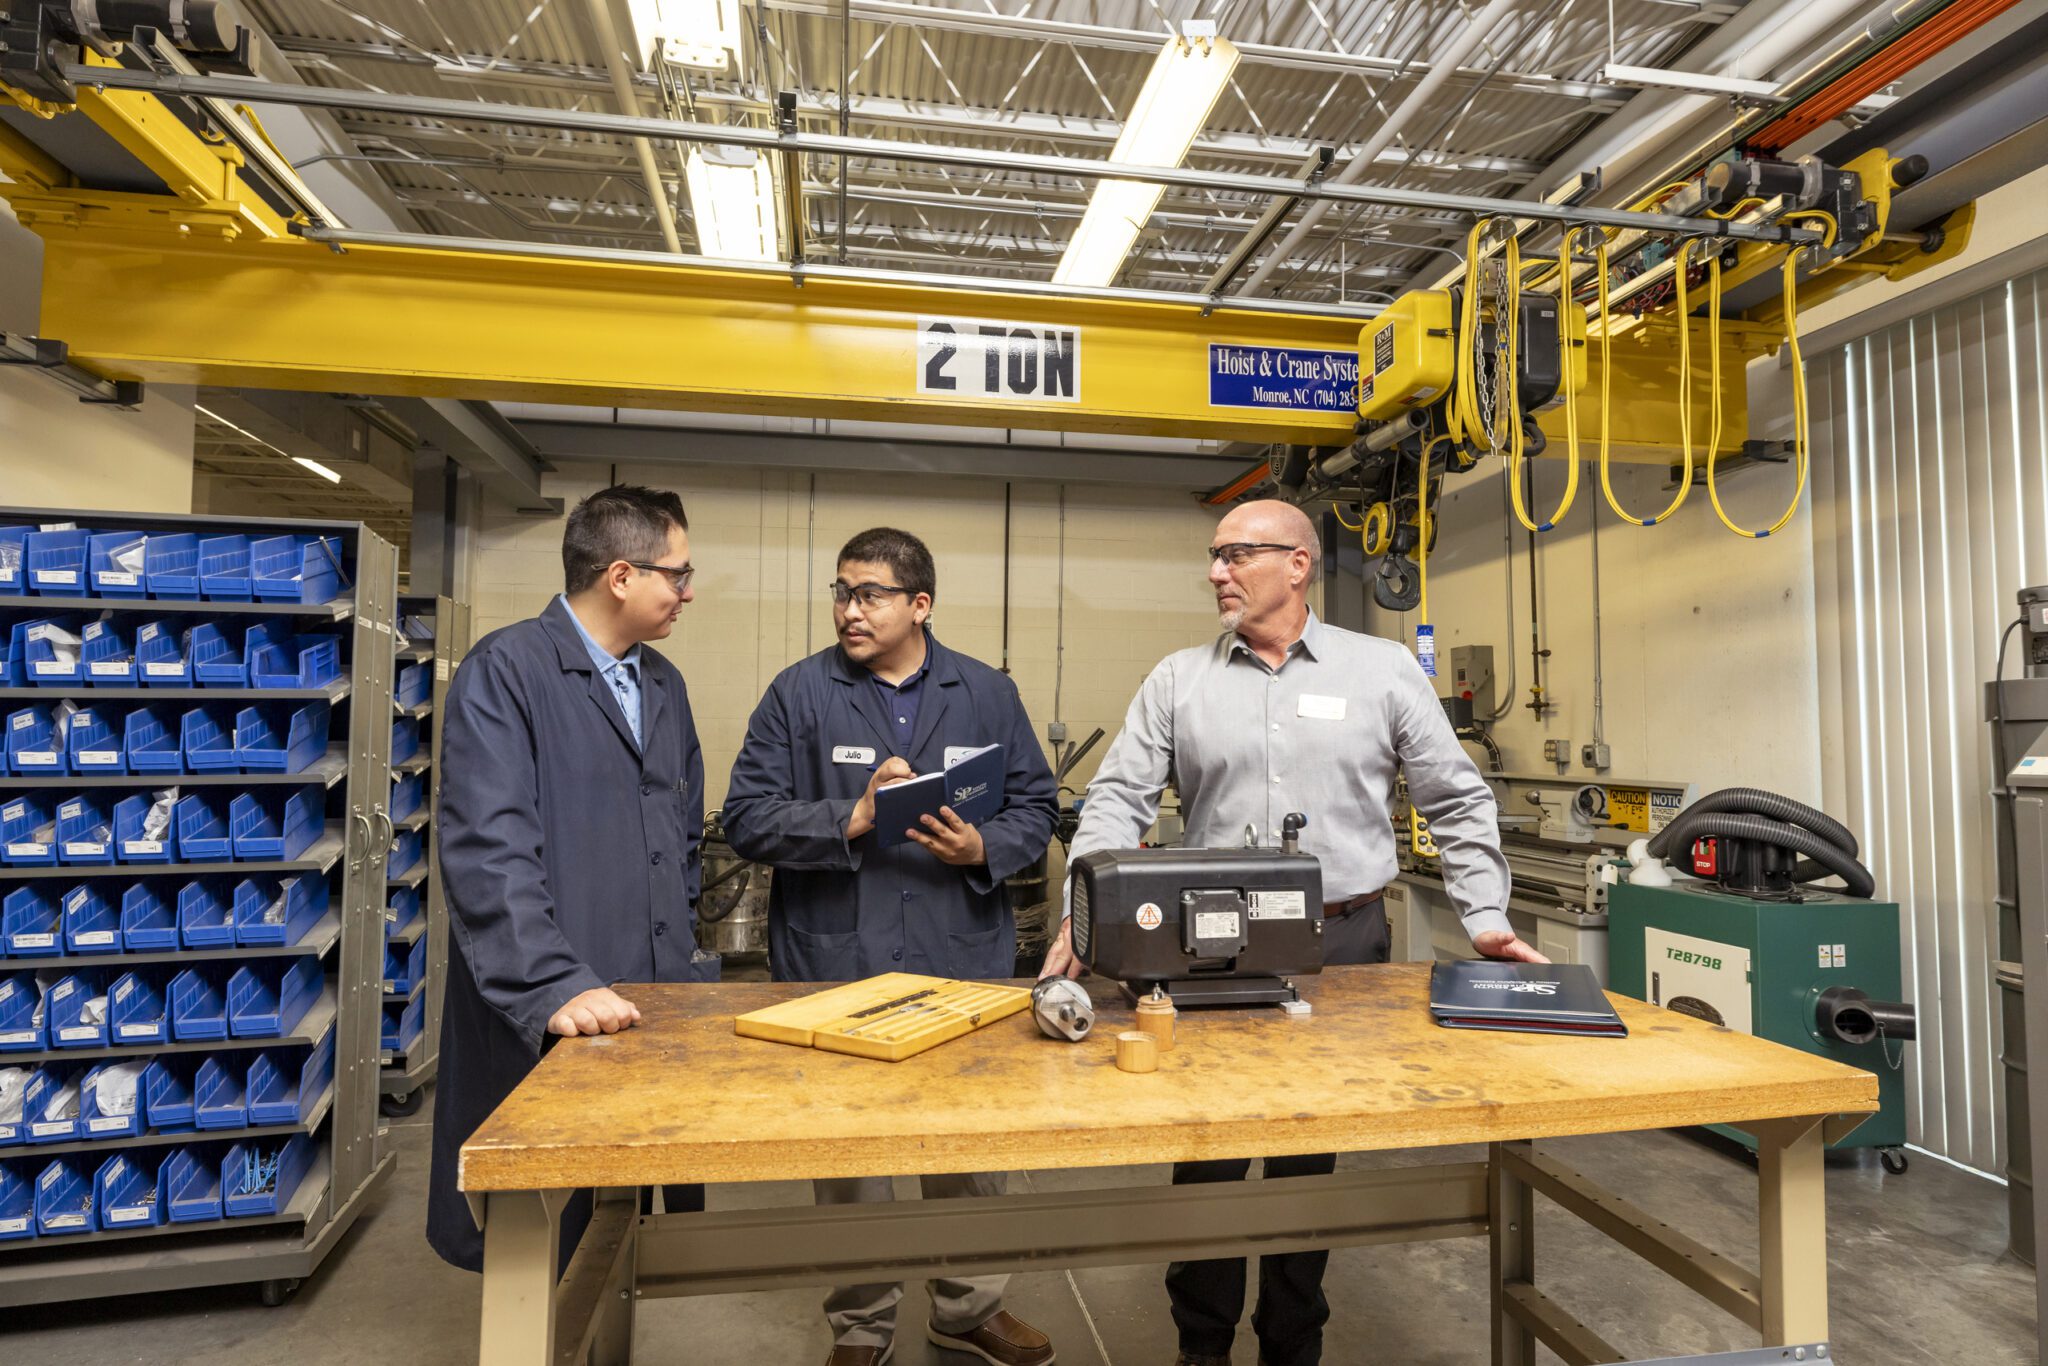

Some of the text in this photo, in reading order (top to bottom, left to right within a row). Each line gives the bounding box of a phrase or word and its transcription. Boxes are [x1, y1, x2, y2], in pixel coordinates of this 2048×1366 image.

[926, 323, 1074, 397] 2 TON
[1217, 349, 1255, 375] Hoist
[1259, 351, 1272, 377] &
[1277, 352, 1320, 378] Crane
[1323, 355, 1359, 387] Syste
[1253, 386, 1292, 406] Monroe,
[1294, 389, 1310, 405] NC
[1313, 389, 1337, 408] (704)
[1339, 391, 1358, 407] 283-
[844, 750, 862, 759] Julio
[1611, 791, 1646, 804] CAUTION
[1653, 794, 1682, 807] NOTIC
[1666, 947, 1722, 970] T28798
